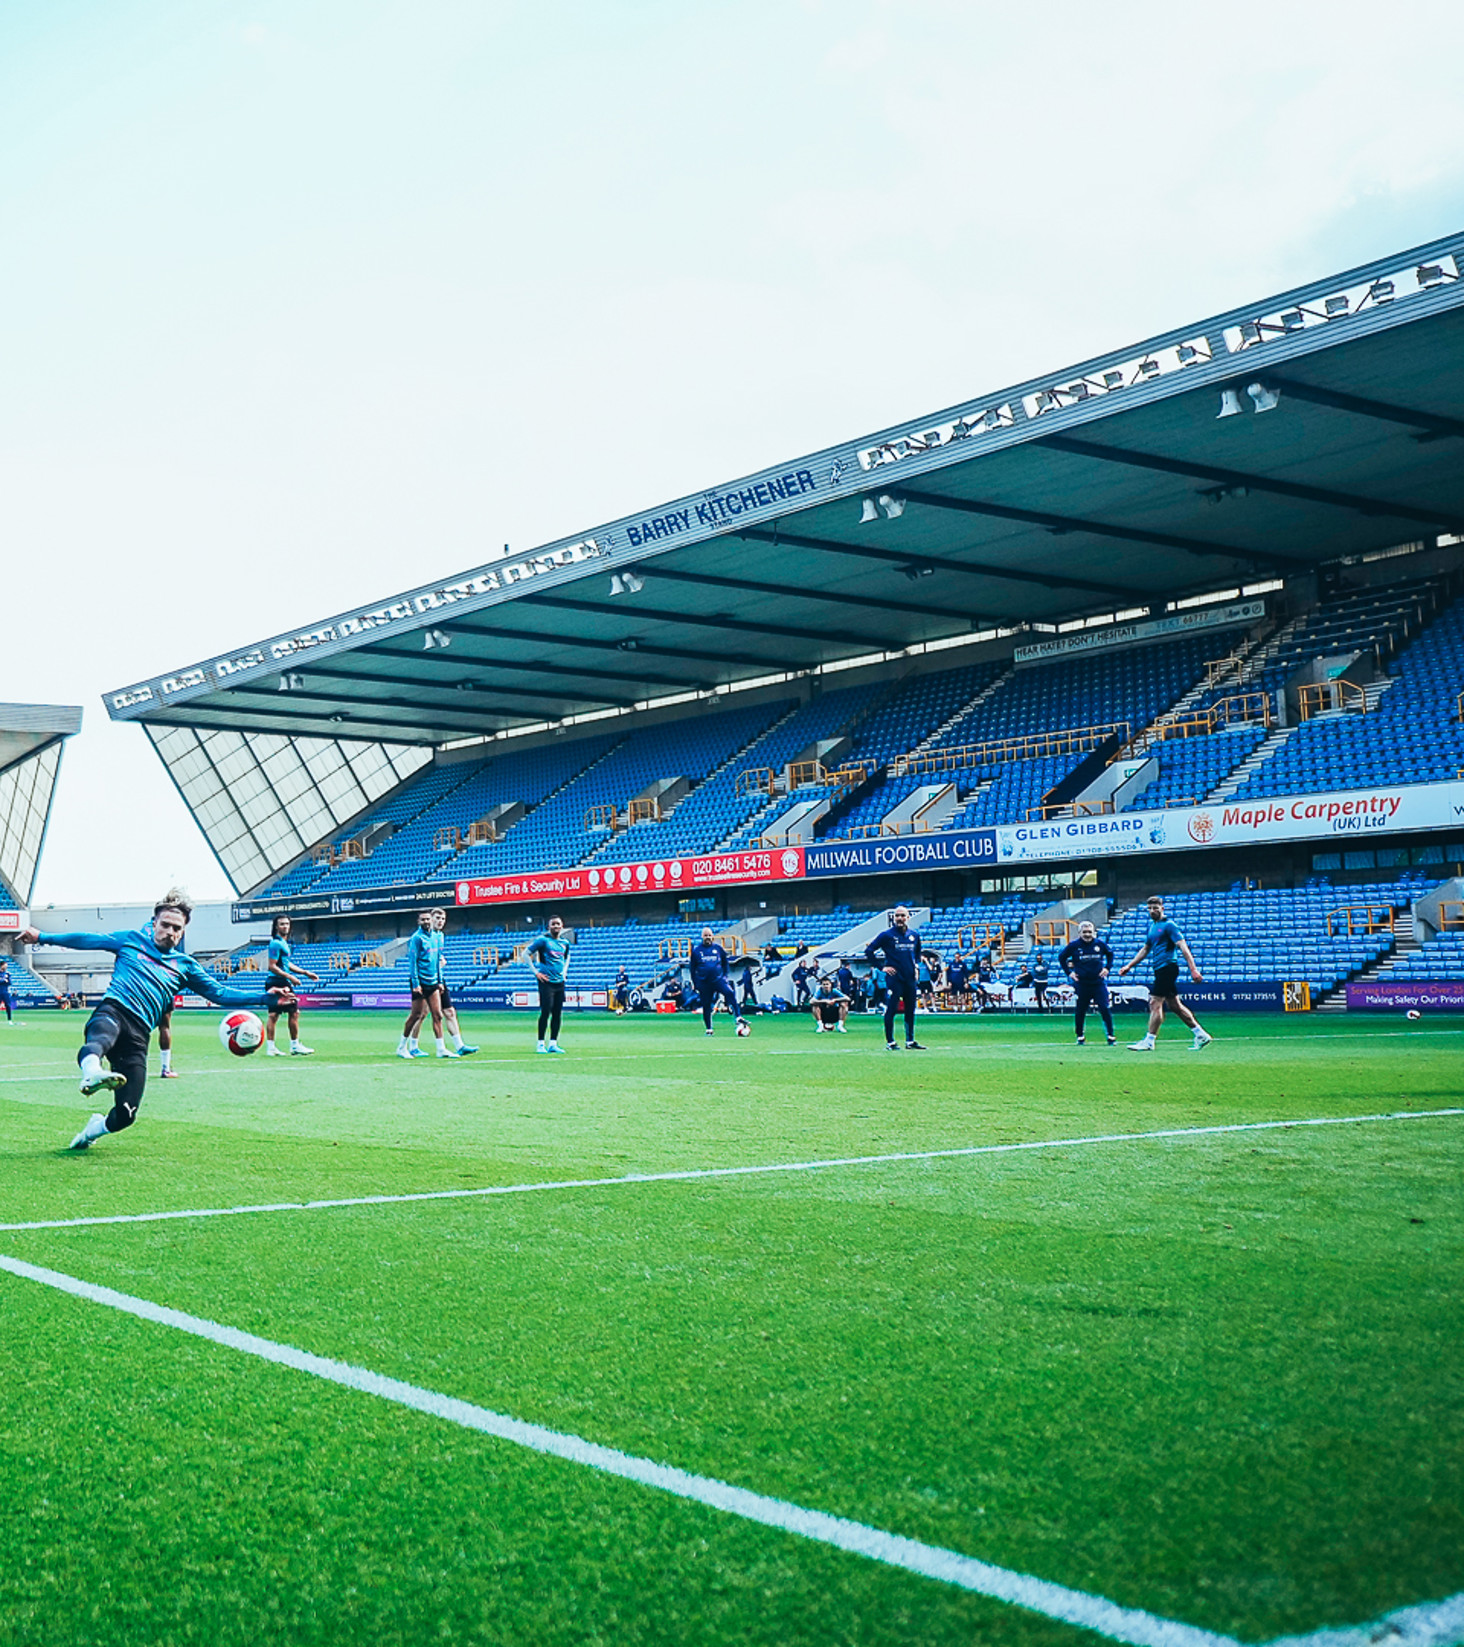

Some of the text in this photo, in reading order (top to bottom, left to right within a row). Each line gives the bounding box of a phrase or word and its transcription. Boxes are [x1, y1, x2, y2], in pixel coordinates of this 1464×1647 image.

[626, 470, 816, 547] BARRY KITCHENER
[1016, 648, 1038, 658] HEAR
[1039, 641, 1066, 653] HATE?
[1068, 634, 1095, 647] DON'T
[1097, 627, 1137, 641] HESITATE
[1222, 796, 1401, 829] Maple Carpentry
[1333, 814, 1386, 832] (UK) Ltd
[1016, 827, 1061, 841] GLEN
[1066, 819, 1143, 836] GIBBARD
[692, 854, 771, 875] 020 8461 5476
[807, 838, 993, 871] MILLWALL FOOTBALL CLUB
[473, 883, 503, 898] Trustee
[504, 881, 520, 894] Fire
[522, 881, 529, 892] &
[530, 878, 565, 894] Security
[566, 876, 580, 890] Ltd
[1178, 992, 1226, 1001] KITCHENS
[1351, 986, 1379, 996] Serving
[1381, 984, 1412, 994] London
[1413, 984, 1427, 993] For
[1429, 983, 1450, 993] Over
[1366, 995, 1394, 1006] Making
[1394, 995, 1419, 1006] Safety
[1421, 994, 1439, 1004] Our
